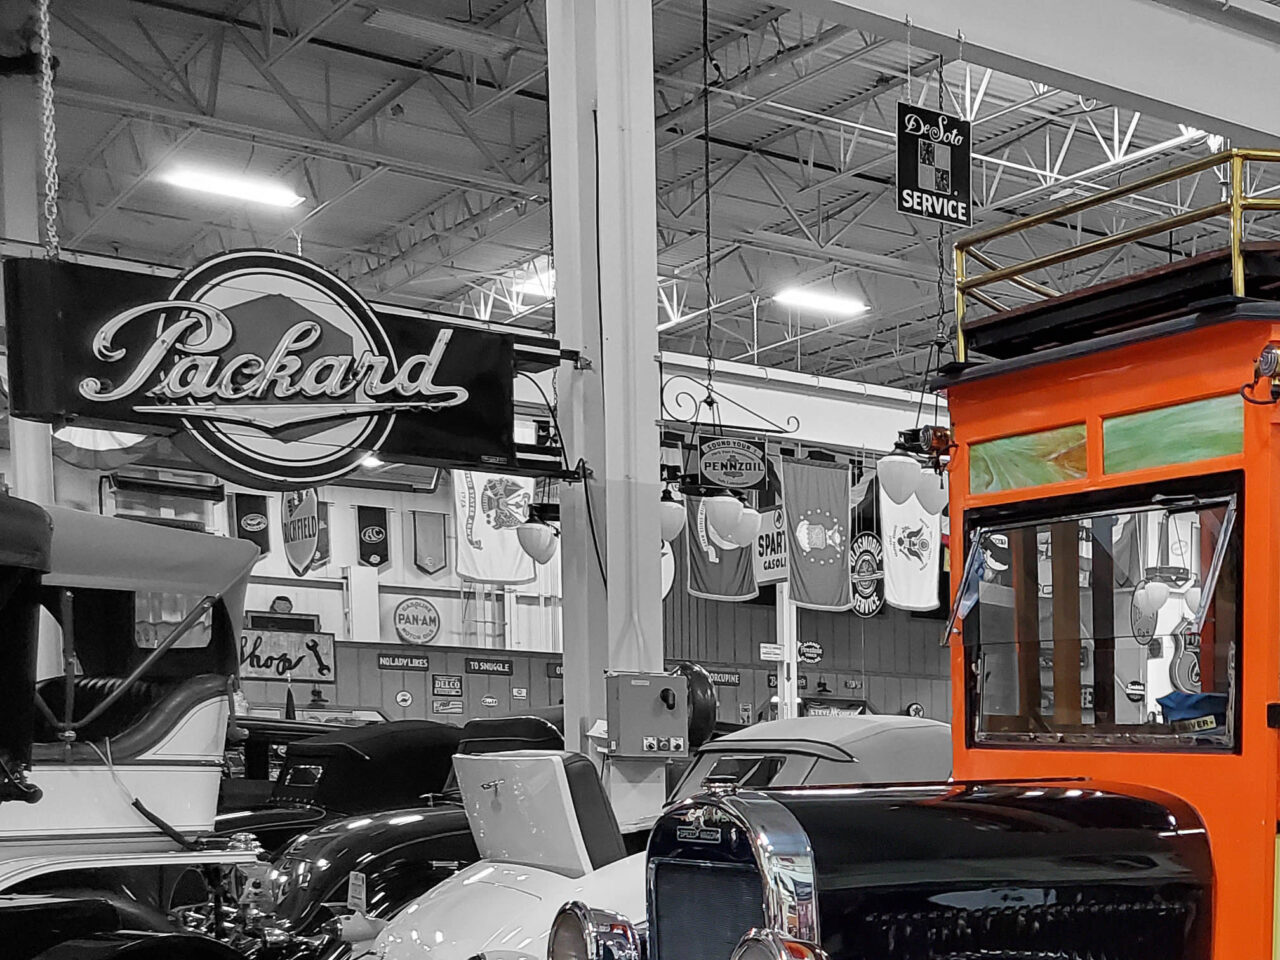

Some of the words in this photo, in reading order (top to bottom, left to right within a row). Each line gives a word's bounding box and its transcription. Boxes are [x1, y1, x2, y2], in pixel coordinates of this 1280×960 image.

[902, 189, 968, 221] SERVICE
[79, 300, 470, 402] Packard
[707, 440, 731, 450] SOUND
[732, 441, 752, 451] YOUR
[704, 461, 765, 472] PENNZOIL
[284, 516, 317, 542] RICHFIELD
[365, 529, 383, 541] AC
[850, 535, 883, 567] OLDSMOBILE
[855, 592, 880, 613] SERVICE
[398, 613, 437, 627] PAN-AM
[380, 657, 390, 666] NO
[390, 657, 408, 666] LADY
[408, 658, 428, 668] LIKES
[470, 661, 479, 670] TO
[480, 662, 510, 672] SNUGGLE
[435, 680, 460, 689] DELCO
